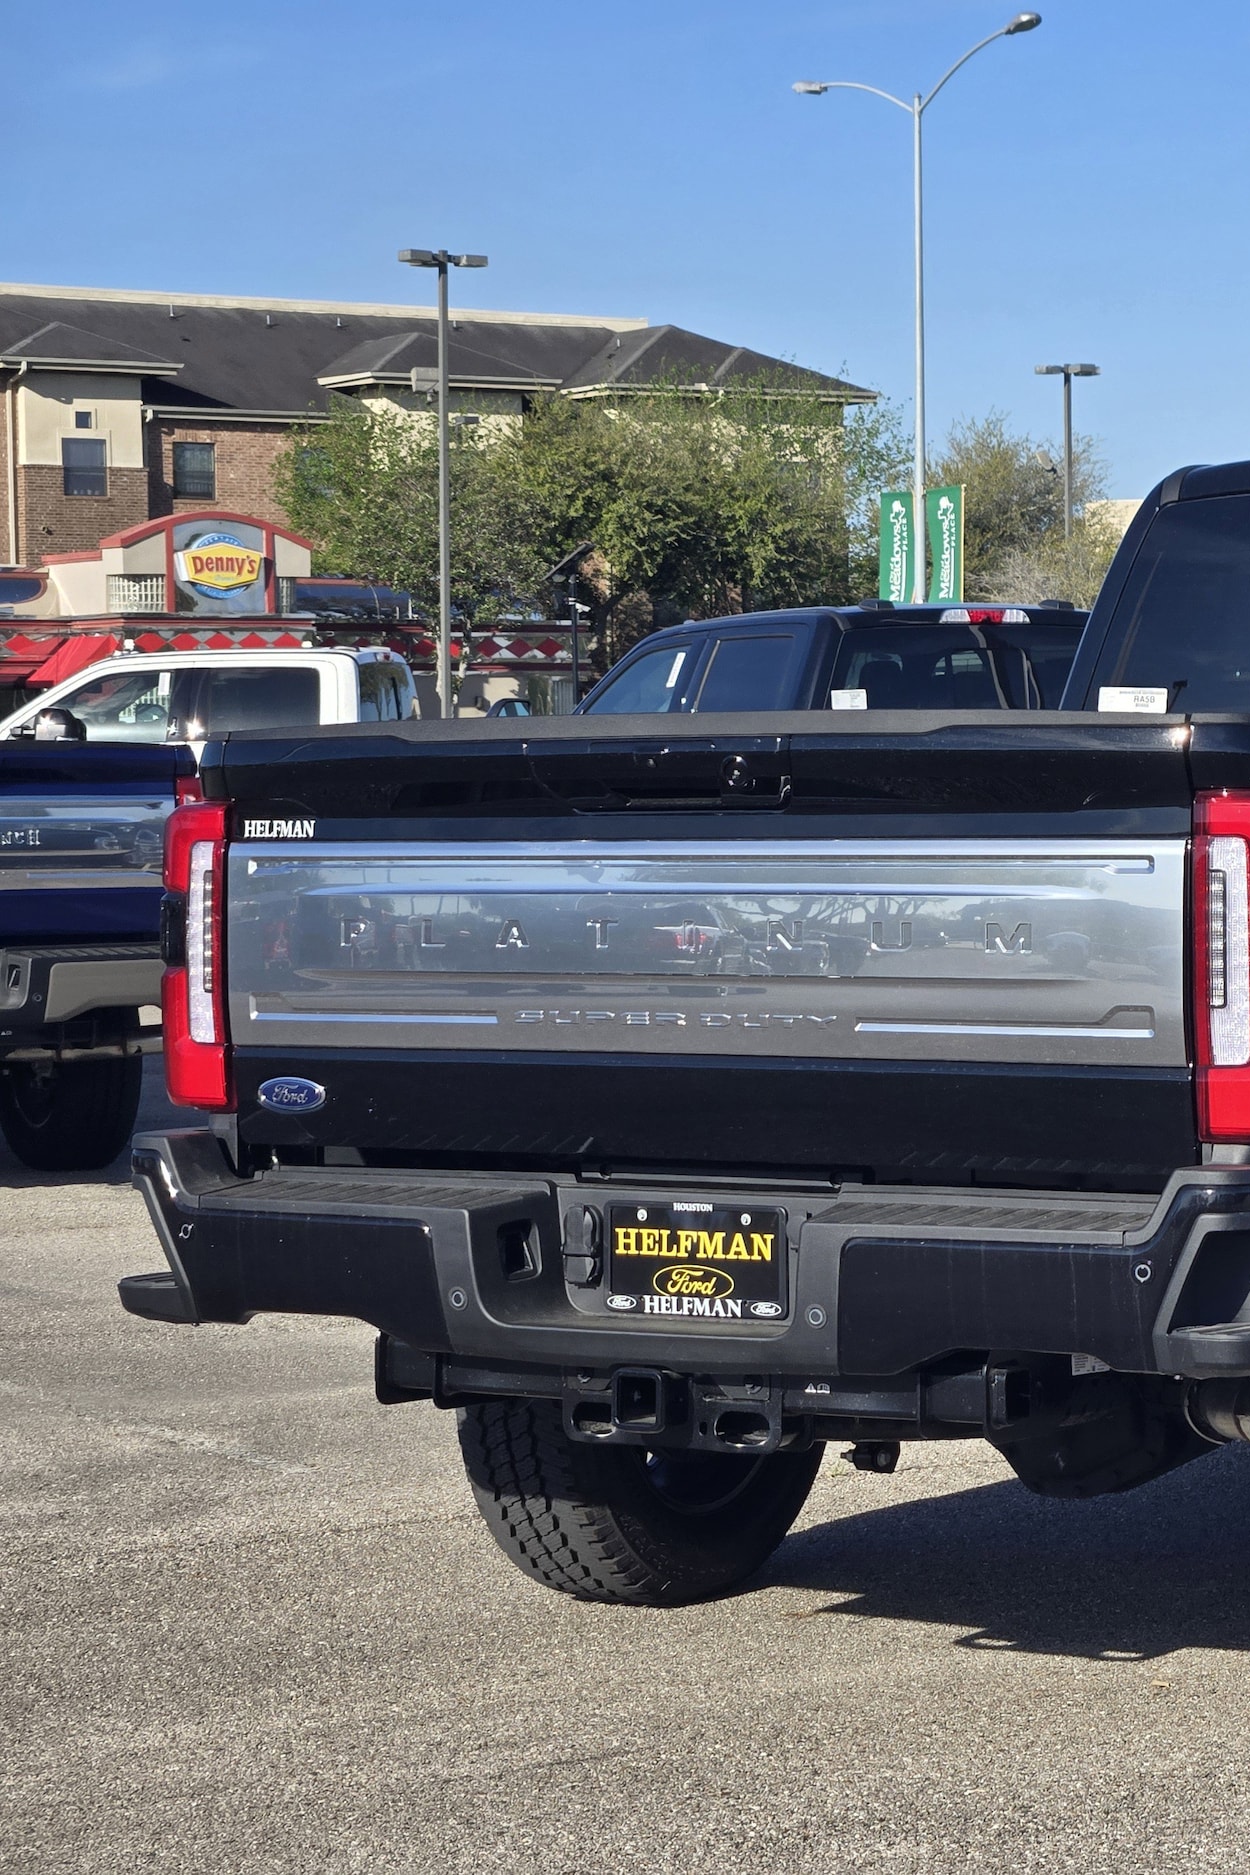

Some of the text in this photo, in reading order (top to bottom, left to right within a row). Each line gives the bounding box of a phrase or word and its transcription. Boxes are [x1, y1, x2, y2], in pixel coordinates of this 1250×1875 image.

[192, 555, 257, 576] Denny's
[889, 522, 901, 602] Meadows
[939, 519, 950, 599] Meadows
[243, 819, 316, 838] HELFMAN
[339, 917, 1034, 954] PLATINUM
[514, 1009, 838, 1031] SUPER DUTY
[271, 1083, 309, 1104] Ford
[673, 1202, 713, 1213] HOUSTON
[614, 1227, 775, 1261] HELFMAN
[666, 1268, 718, 1296] Ford
[611, 1296, 632, 1308] Ford
[642, 1294, 743, 1319] HELFMAN
[754, 1303, 776, 1315] Ford
